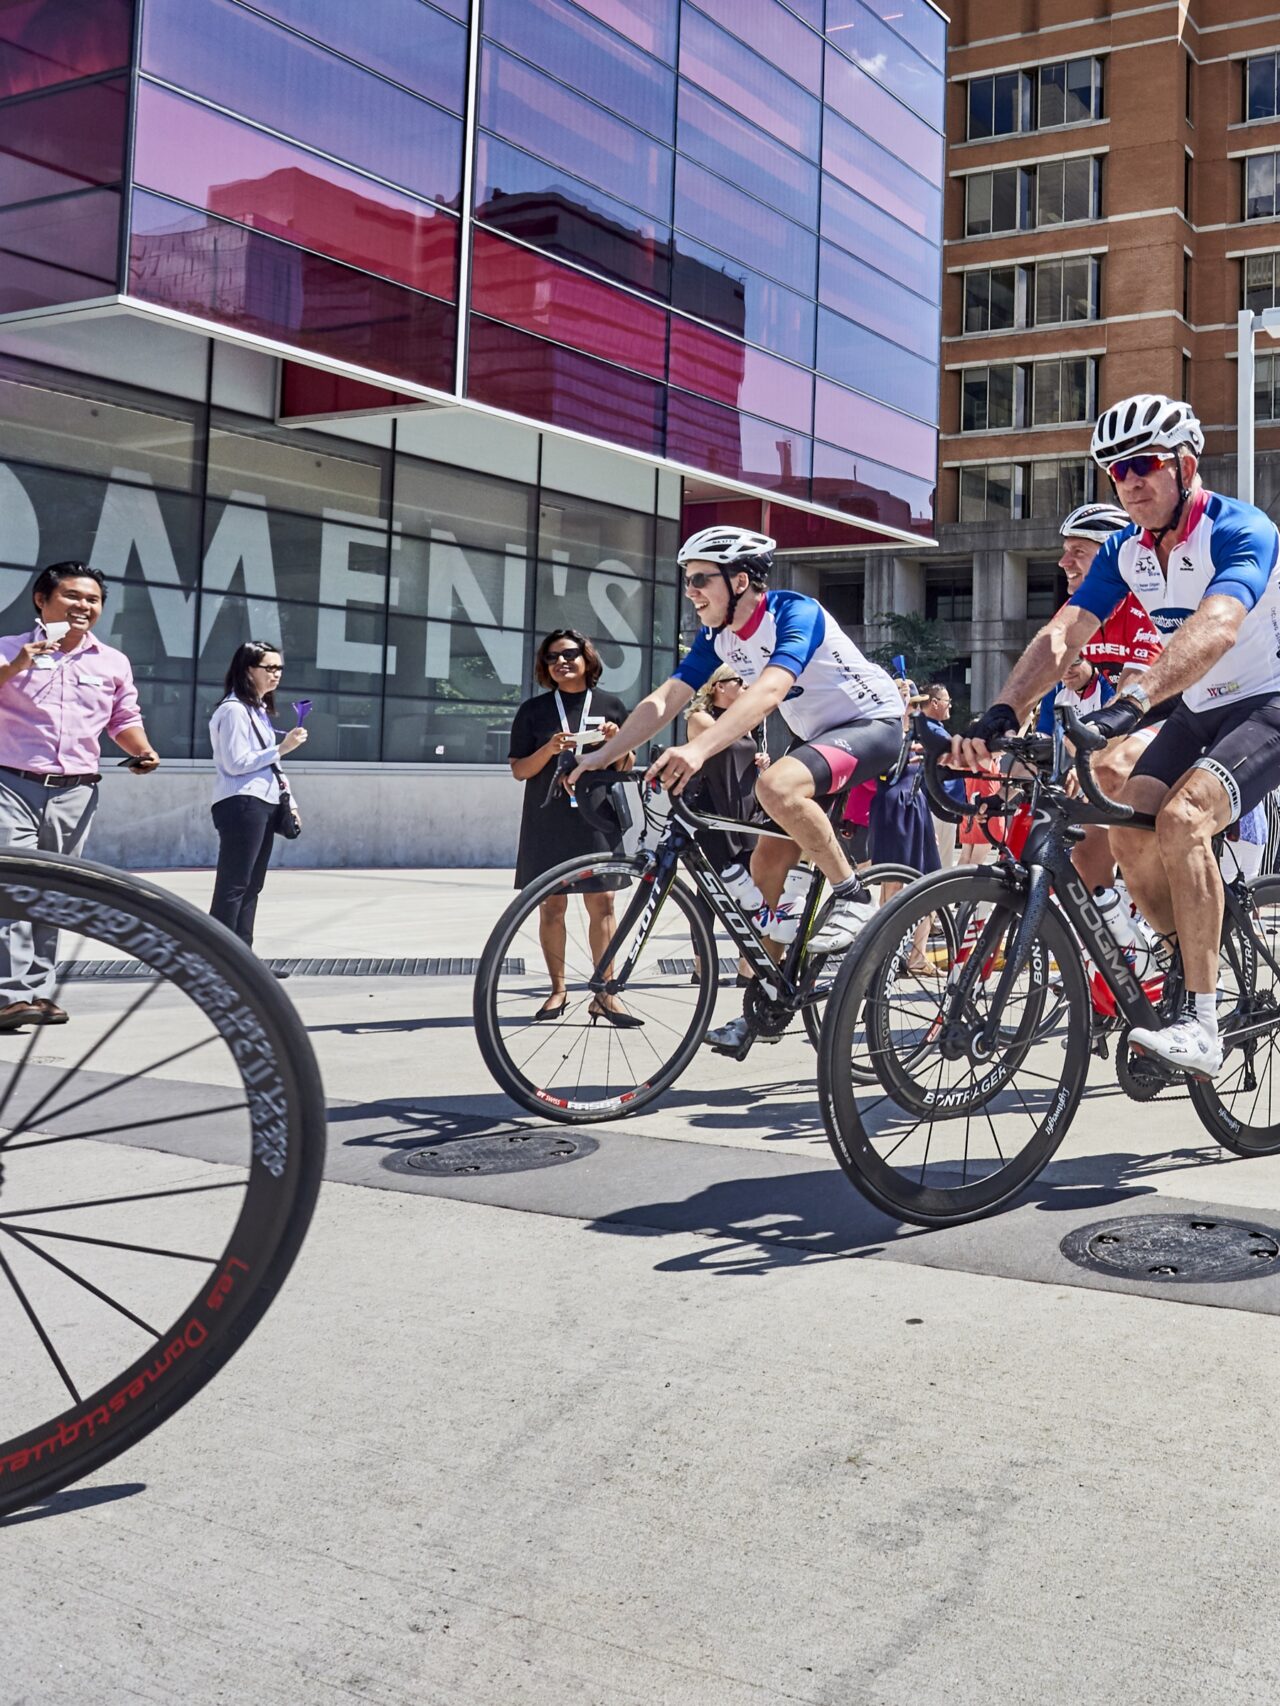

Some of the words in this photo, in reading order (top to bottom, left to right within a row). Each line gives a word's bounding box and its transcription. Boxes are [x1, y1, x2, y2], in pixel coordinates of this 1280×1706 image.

[629, 877, 661, 964] SCOTT
[696, 870, 777, 972] SCOTT
[1066, 879, 1140, 1004] DOGMA
[207, 1256, 249, 1309] Les
